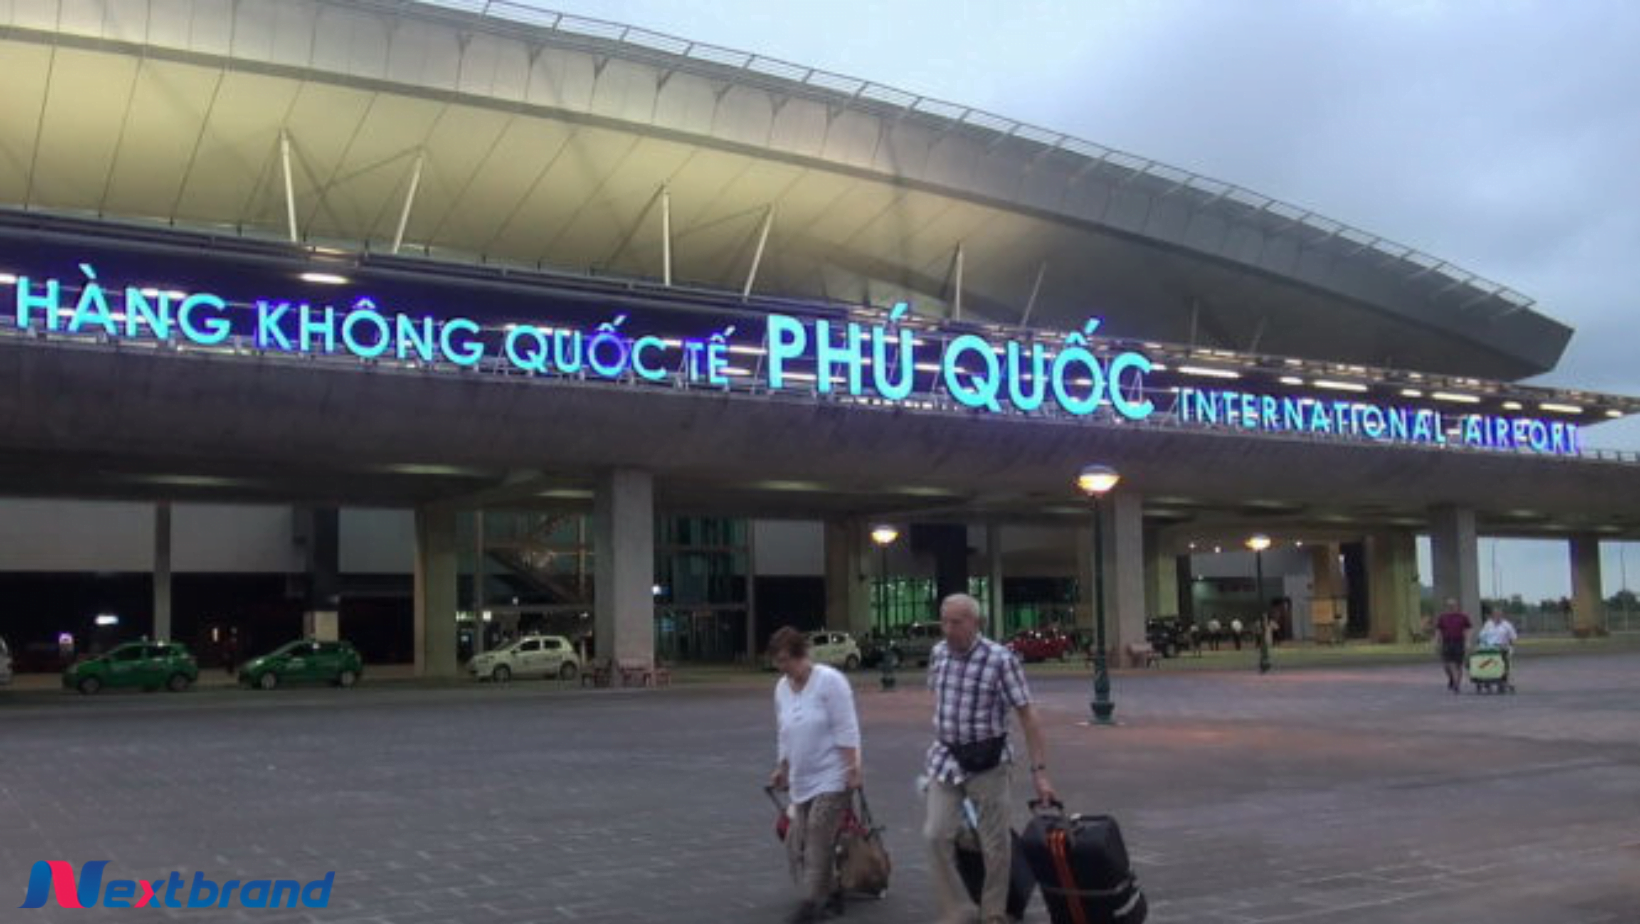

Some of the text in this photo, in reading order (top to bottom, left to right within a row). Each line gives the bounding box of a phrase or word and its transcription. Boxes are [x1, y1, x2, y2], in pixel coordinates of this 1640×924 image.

[15, 263, 1580, 455] HÀNG KHÔNG QUỐC TẾ PHÚ QUỐC INTERNATIONAL AIRPORT
